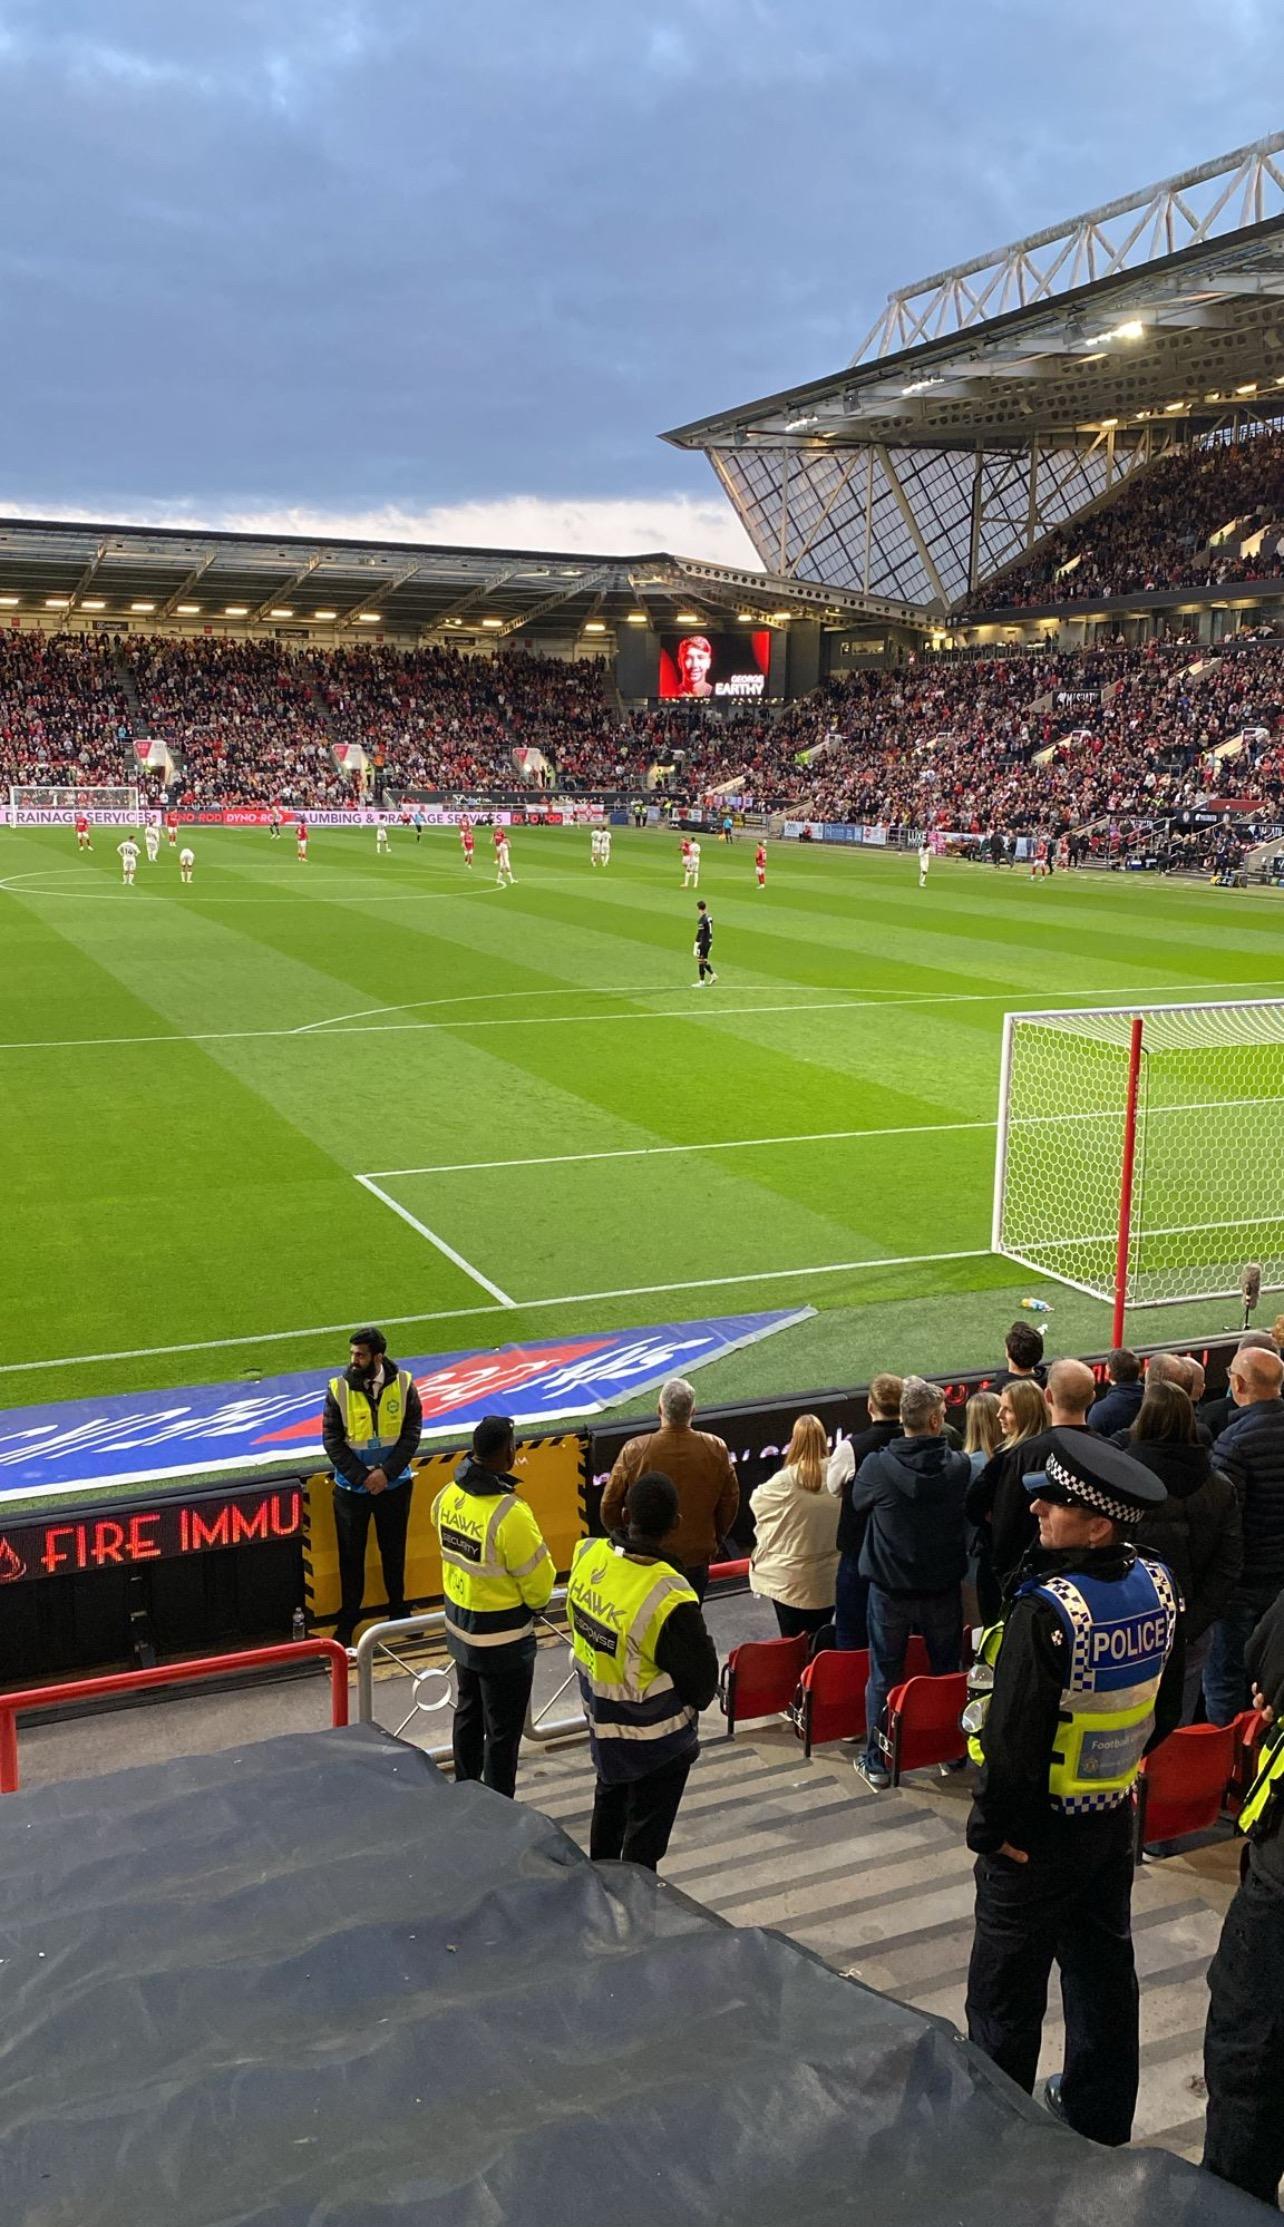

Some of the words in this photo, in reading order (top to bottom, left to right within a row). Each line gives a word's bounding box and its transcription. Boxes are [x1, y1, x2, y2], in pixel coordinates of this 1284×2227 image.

[715, 683, 764, 696] EARTHY
[367, 813, 376, 824] &
[41, 1514, 161, 1573] FIRE
[180, 1493, 299, 1551] IMMU
[440, 1508, 484, 1539] HAWK
[443, 1532, 479, 1555] SECURITY
[570, 1578, 627, 1633] HAWK
[1093, 1617, 1166, 1663] POLICE
